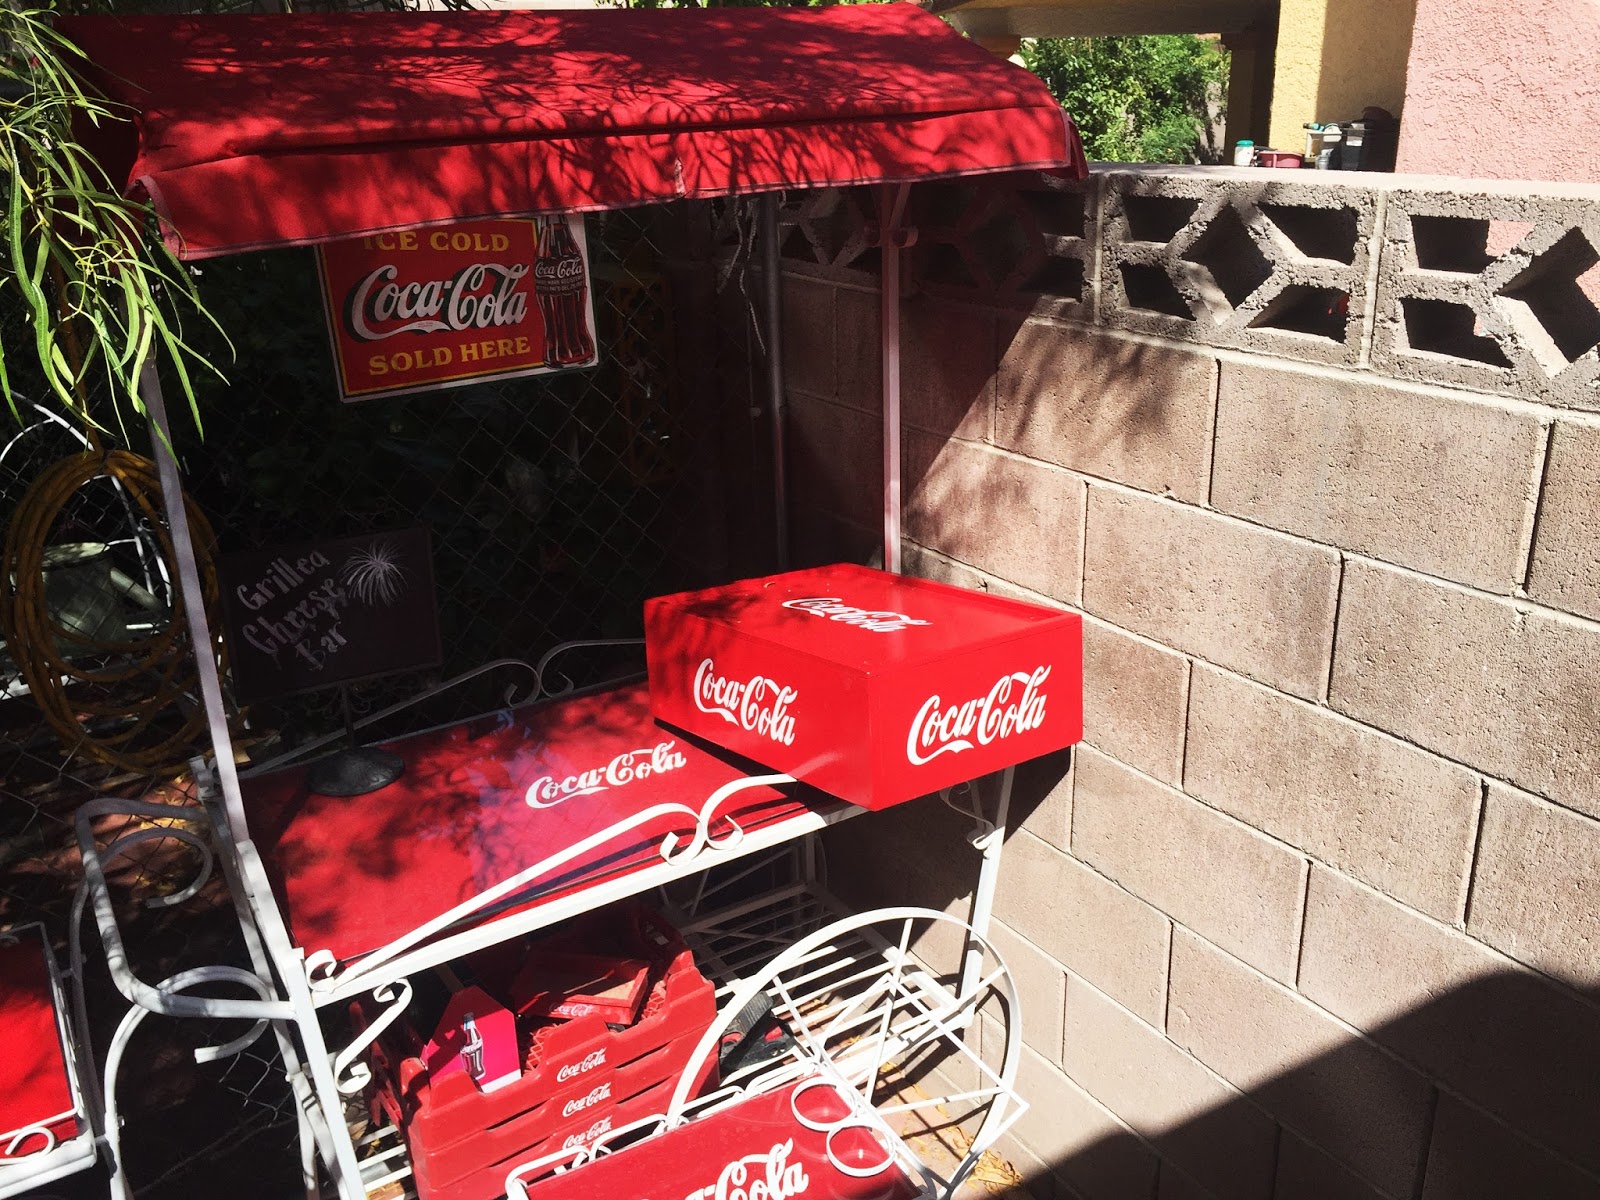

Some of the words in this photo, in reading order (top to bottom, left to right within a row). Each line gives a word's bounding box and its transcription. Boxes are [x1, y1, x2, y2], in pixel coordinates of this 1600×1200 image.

[363, 231, 418, 251] ICE
[430, 231, 509, 251] COLD
[351, 263, 530, 340] Coca-Cola
[368, 346, 452, 376] SOLD
[460, 336, 531, 364] HERE
[781, 597, 934, 633] Coca-Cola
[295, 621, 348, 671] Bar
[693, 658, 798, 747] Coca-Cola
[906, 664, 1052, 766] Coca-Cola
[525, 740, 687, 809] Coca-Cola
